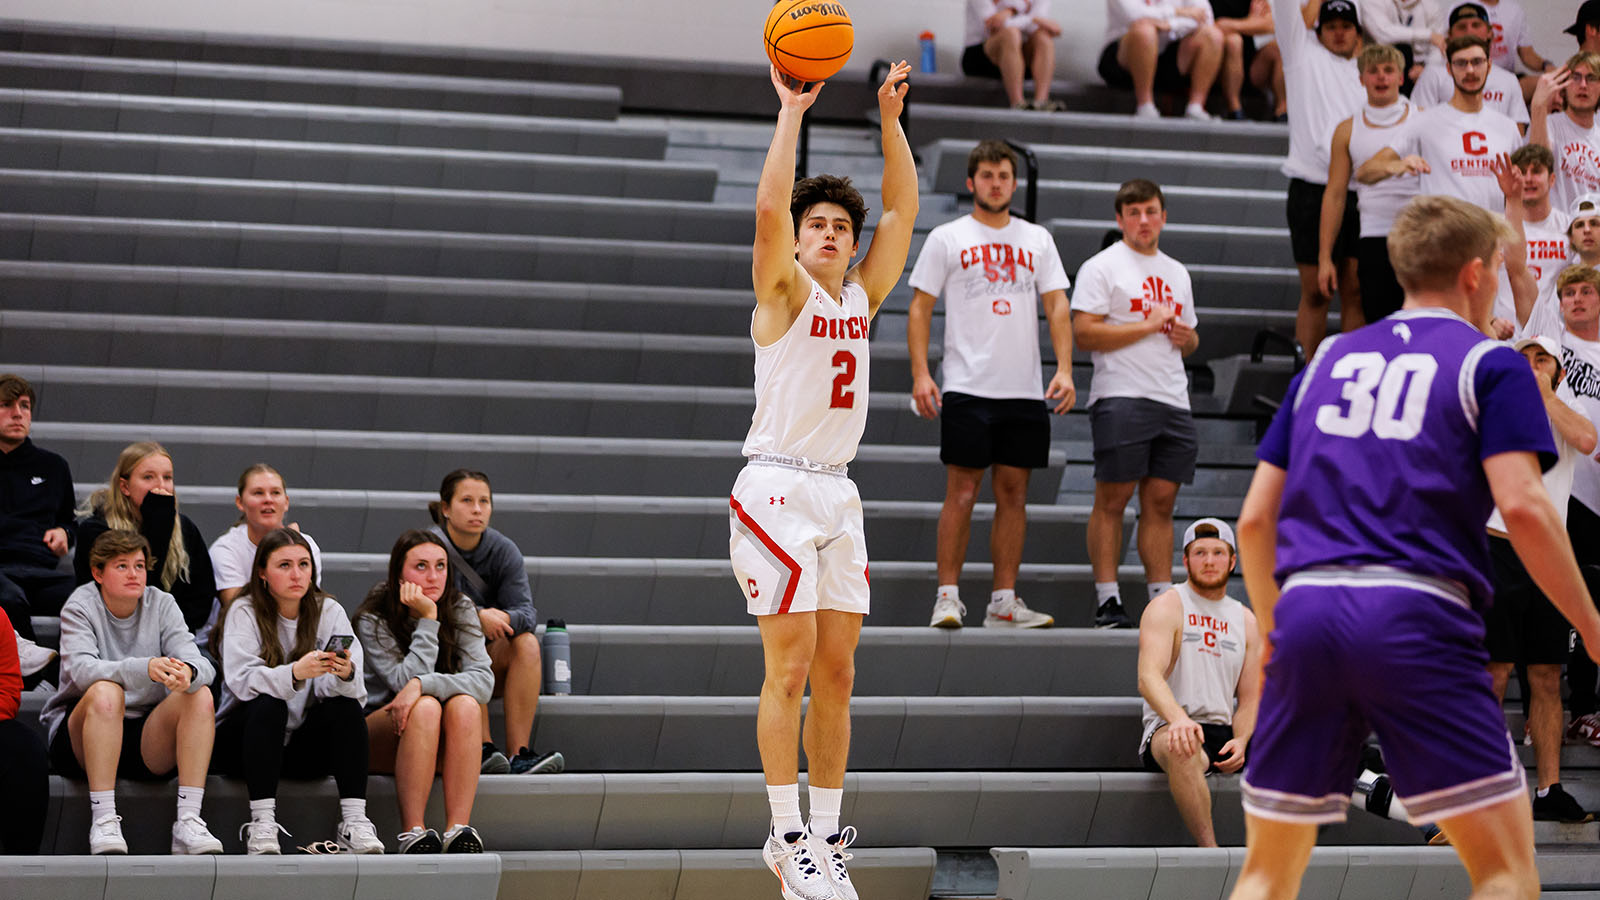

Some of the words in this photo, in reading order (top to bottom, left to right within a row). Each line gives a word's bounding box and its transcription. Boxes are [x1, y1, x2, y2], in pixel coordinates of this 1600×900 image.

[791, 3, 847, 20] Wilson
[1462, 131, 1488, 156] C
[960, 243, 1034, 273] CENTRAL
[1527, 240, 1567, 260] TRAL
[829, 350, 857, 409] 2
[1315, 352, 1438, 440] 30
[747, 578, 759, 599] C
[1188, 613, 1229, 634] DUTCH
[1204, 631, 1216, 647] C
